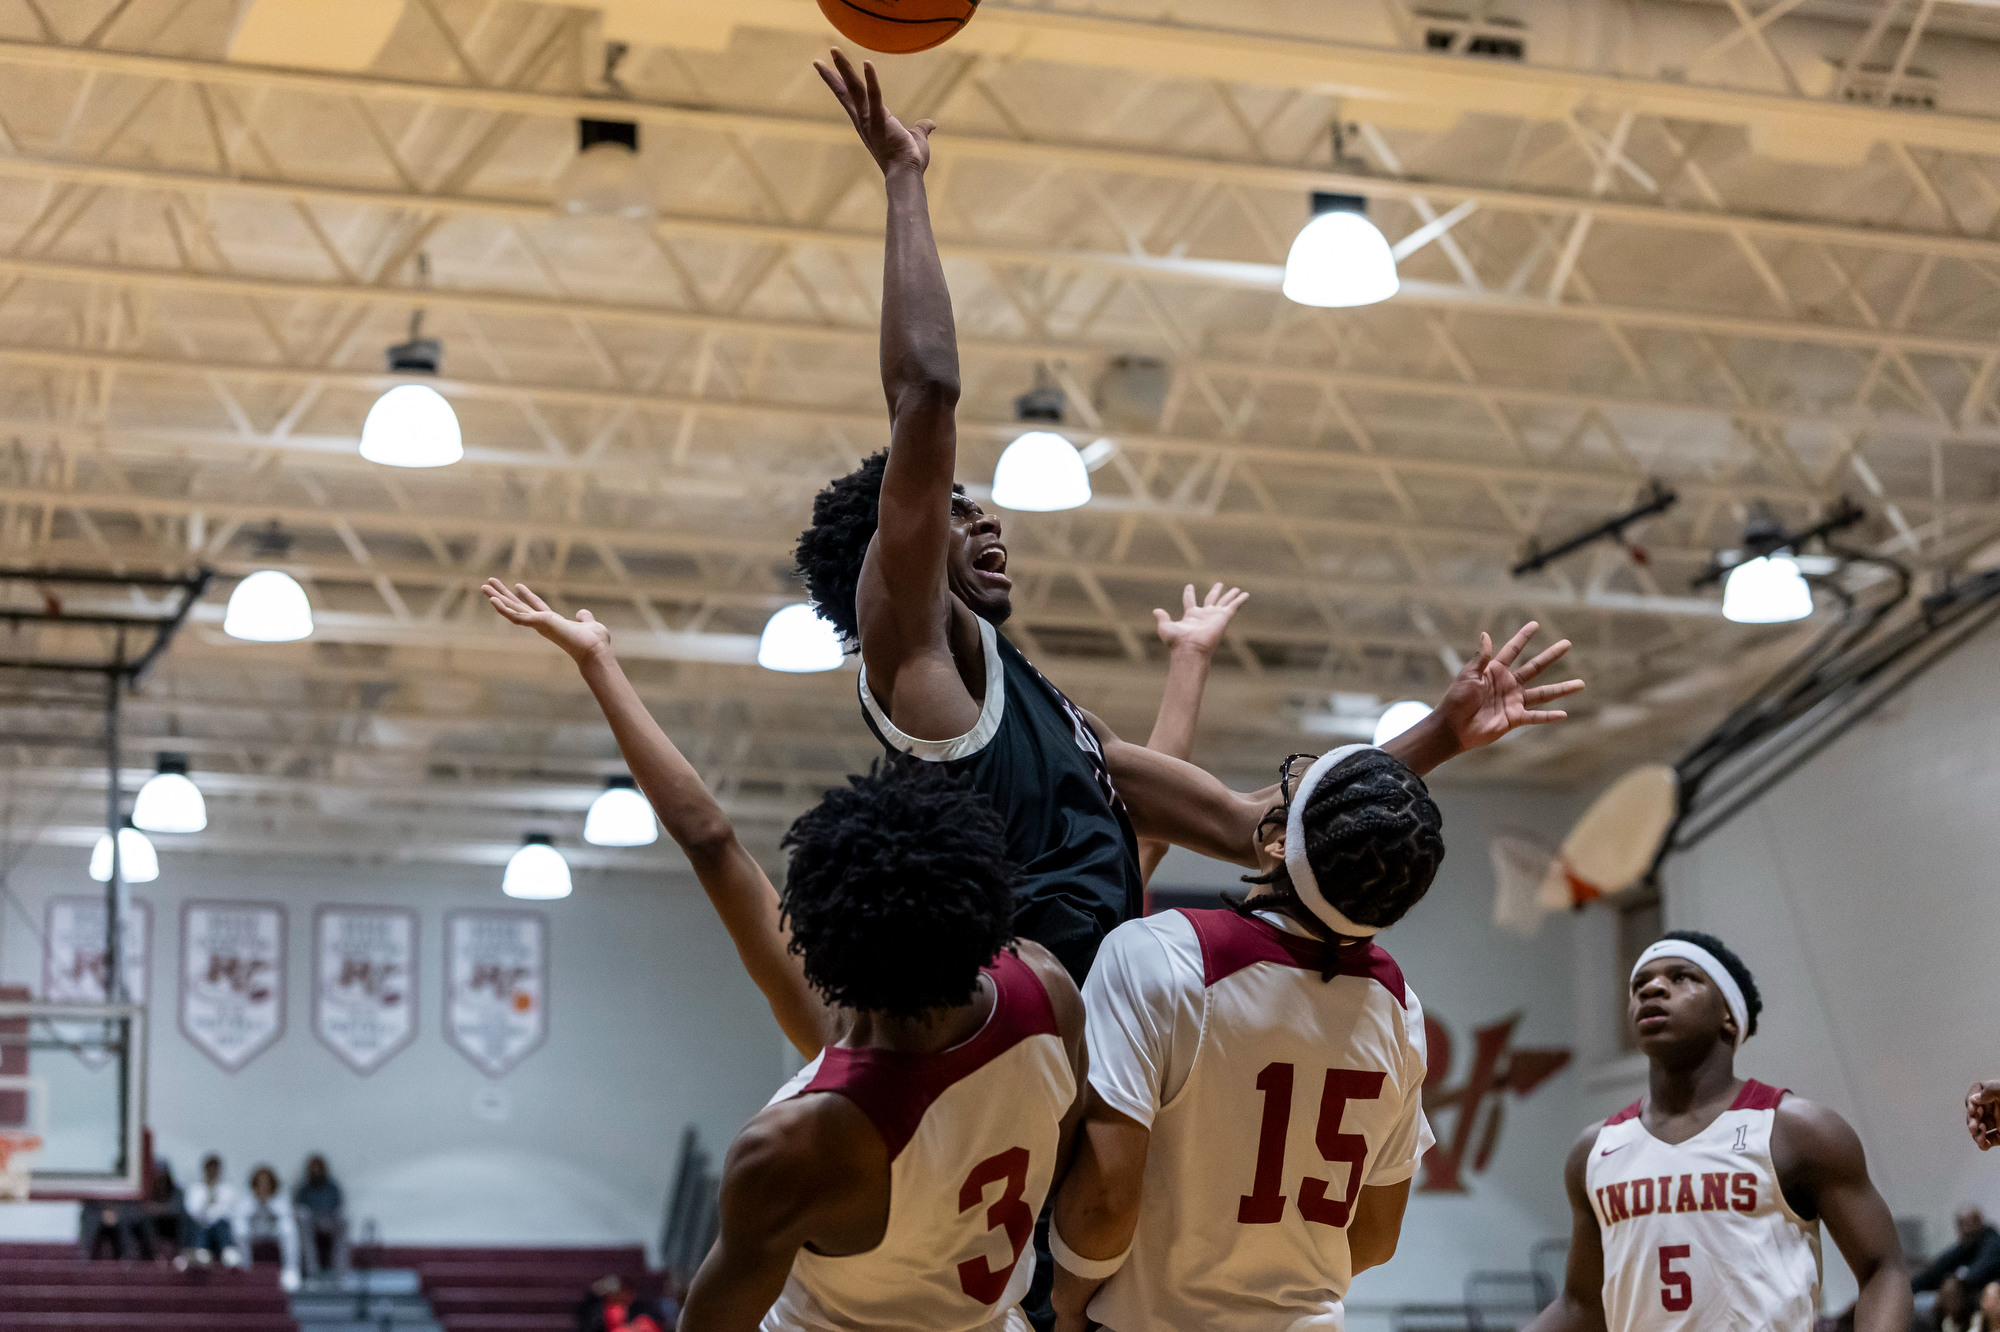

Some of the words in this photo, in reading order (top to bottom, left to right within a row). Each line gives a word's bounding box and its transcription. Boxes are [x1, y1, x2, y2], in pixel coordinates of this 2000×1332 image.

[1237, 1062, 1387, 1228] 15
[1732, 1124, 1748, 1150] 1
[957, 1146, 1033, 1306] 3
[1595, 1172, 1758, 1226] INDIANS
[1658, 1244, 1693, 1312] 5
